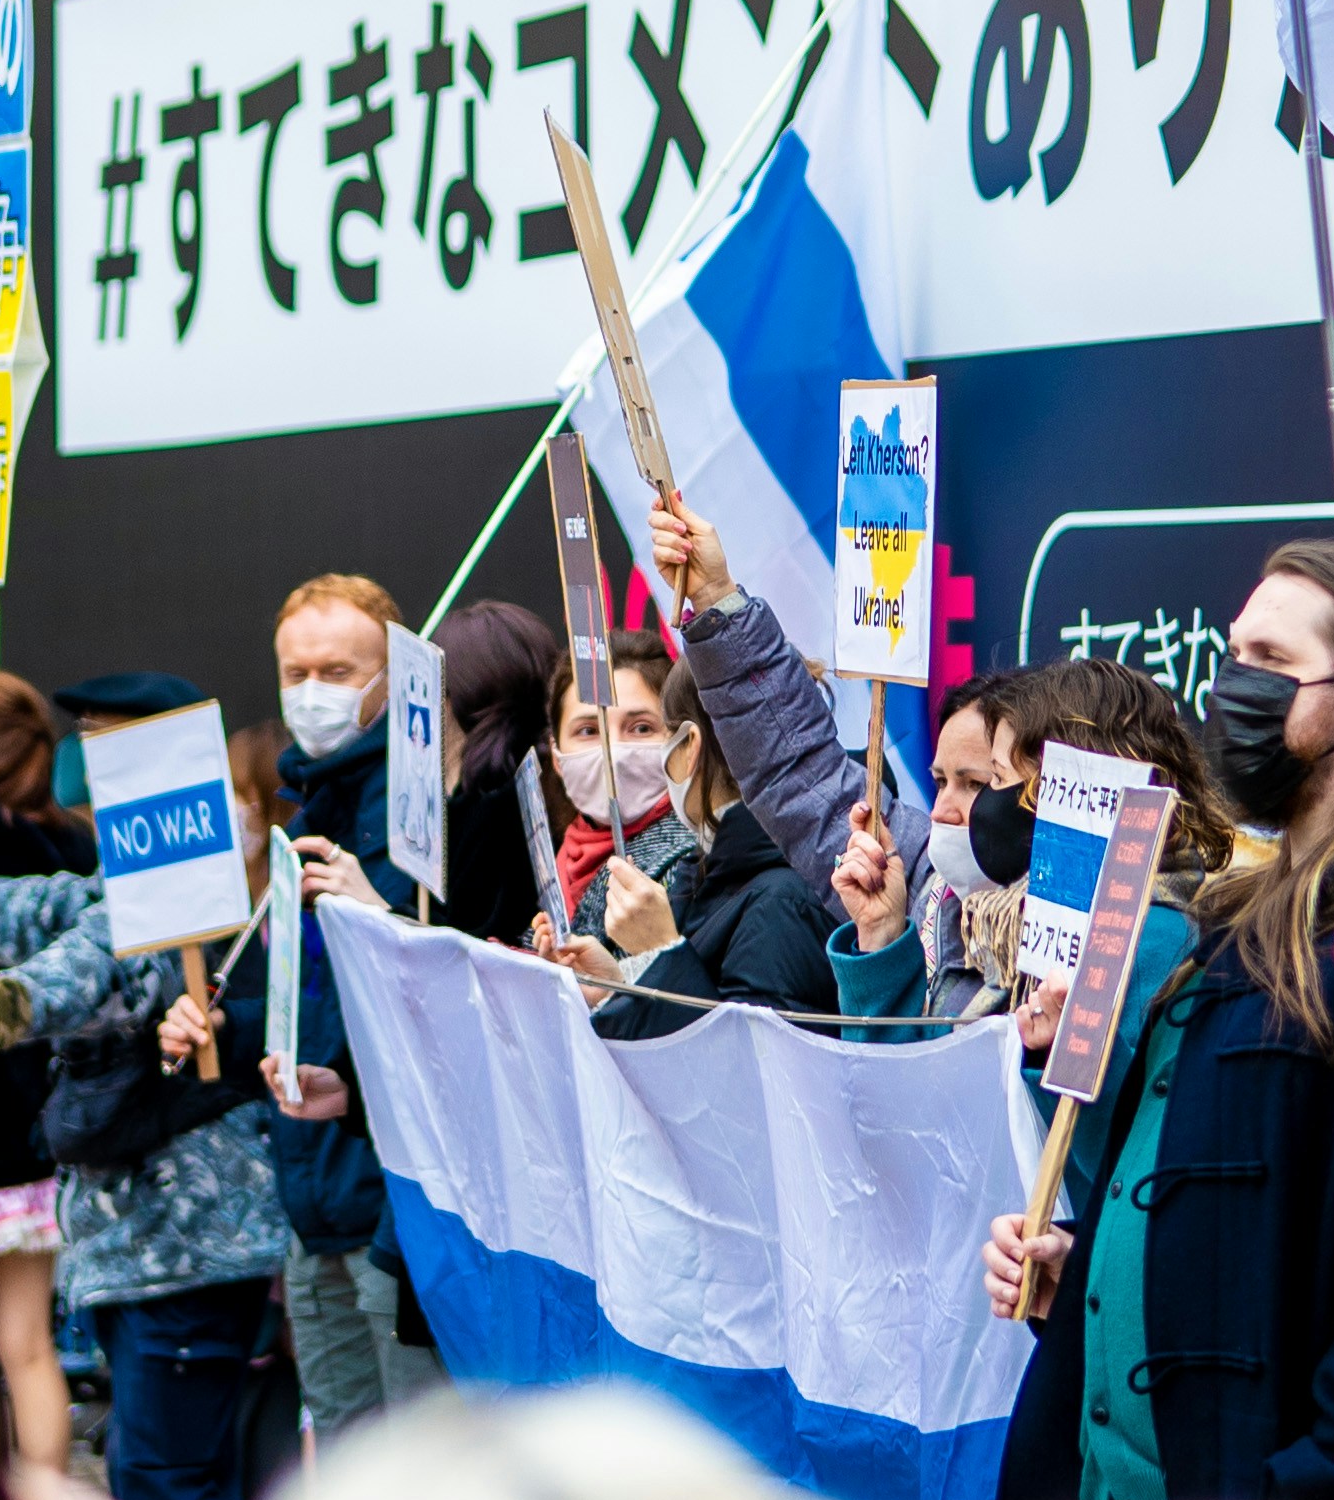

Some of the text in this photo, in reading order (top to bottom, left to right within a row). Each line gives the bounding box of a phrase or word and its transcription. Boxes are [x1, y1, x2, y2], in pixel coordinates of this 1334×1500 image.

[842, 434, 929, 476] Left Kherson?
[854, 510, 908, 552] Leave all
[854, 586, 905, 628] Ukraine!
[110, 800, 216, 862] NO WAR
